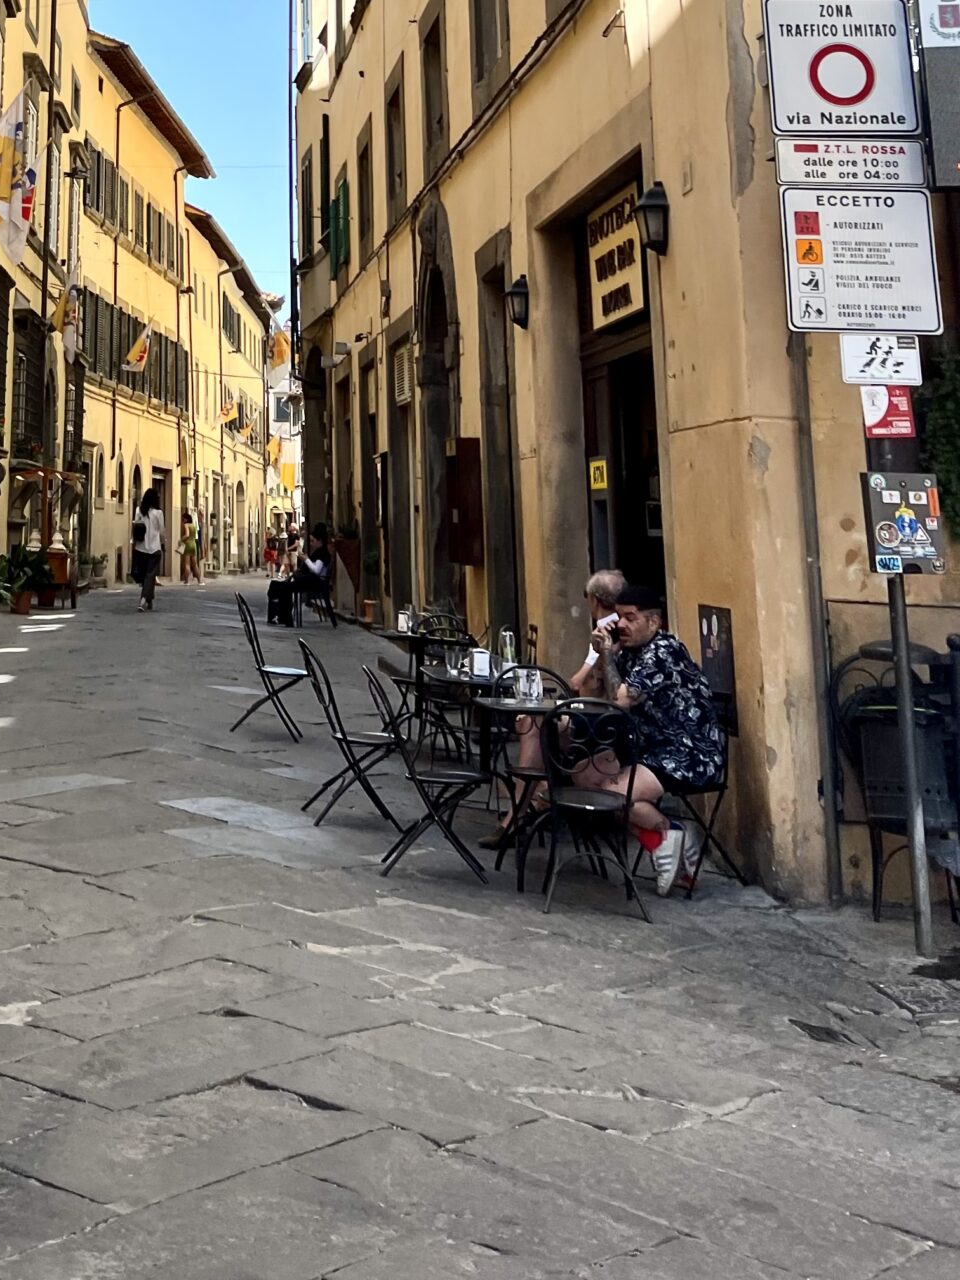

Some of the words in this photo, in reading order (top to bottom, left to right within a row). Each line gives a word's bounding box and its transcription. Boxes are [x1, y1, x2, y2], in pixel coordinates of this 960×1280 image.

[819, 4, 853, 18] ZONA
[778, 23, 839, 37] TRAFFICO
[843, 23, 897, 37] LIMITATO
[786, 112, 811, 125] via
[820, 112, 907, 126] Nazionale
[824, 145, 856, 154] Z.T.L.
[862, 145, 906, 155] ROSSA
[803, 157, 833, 167] dalle
[838, 159, 858, 167] ore
[863, 158, 899, 168] 10:00
[804, 169, 827, 179] alle
[839, 171, 858, 180] ore
[864, 170, 900, 180] 04:00
[816, 195, 895, 208] ECCETTO
[833, 222, 884, 230] AUTORIZZATI
